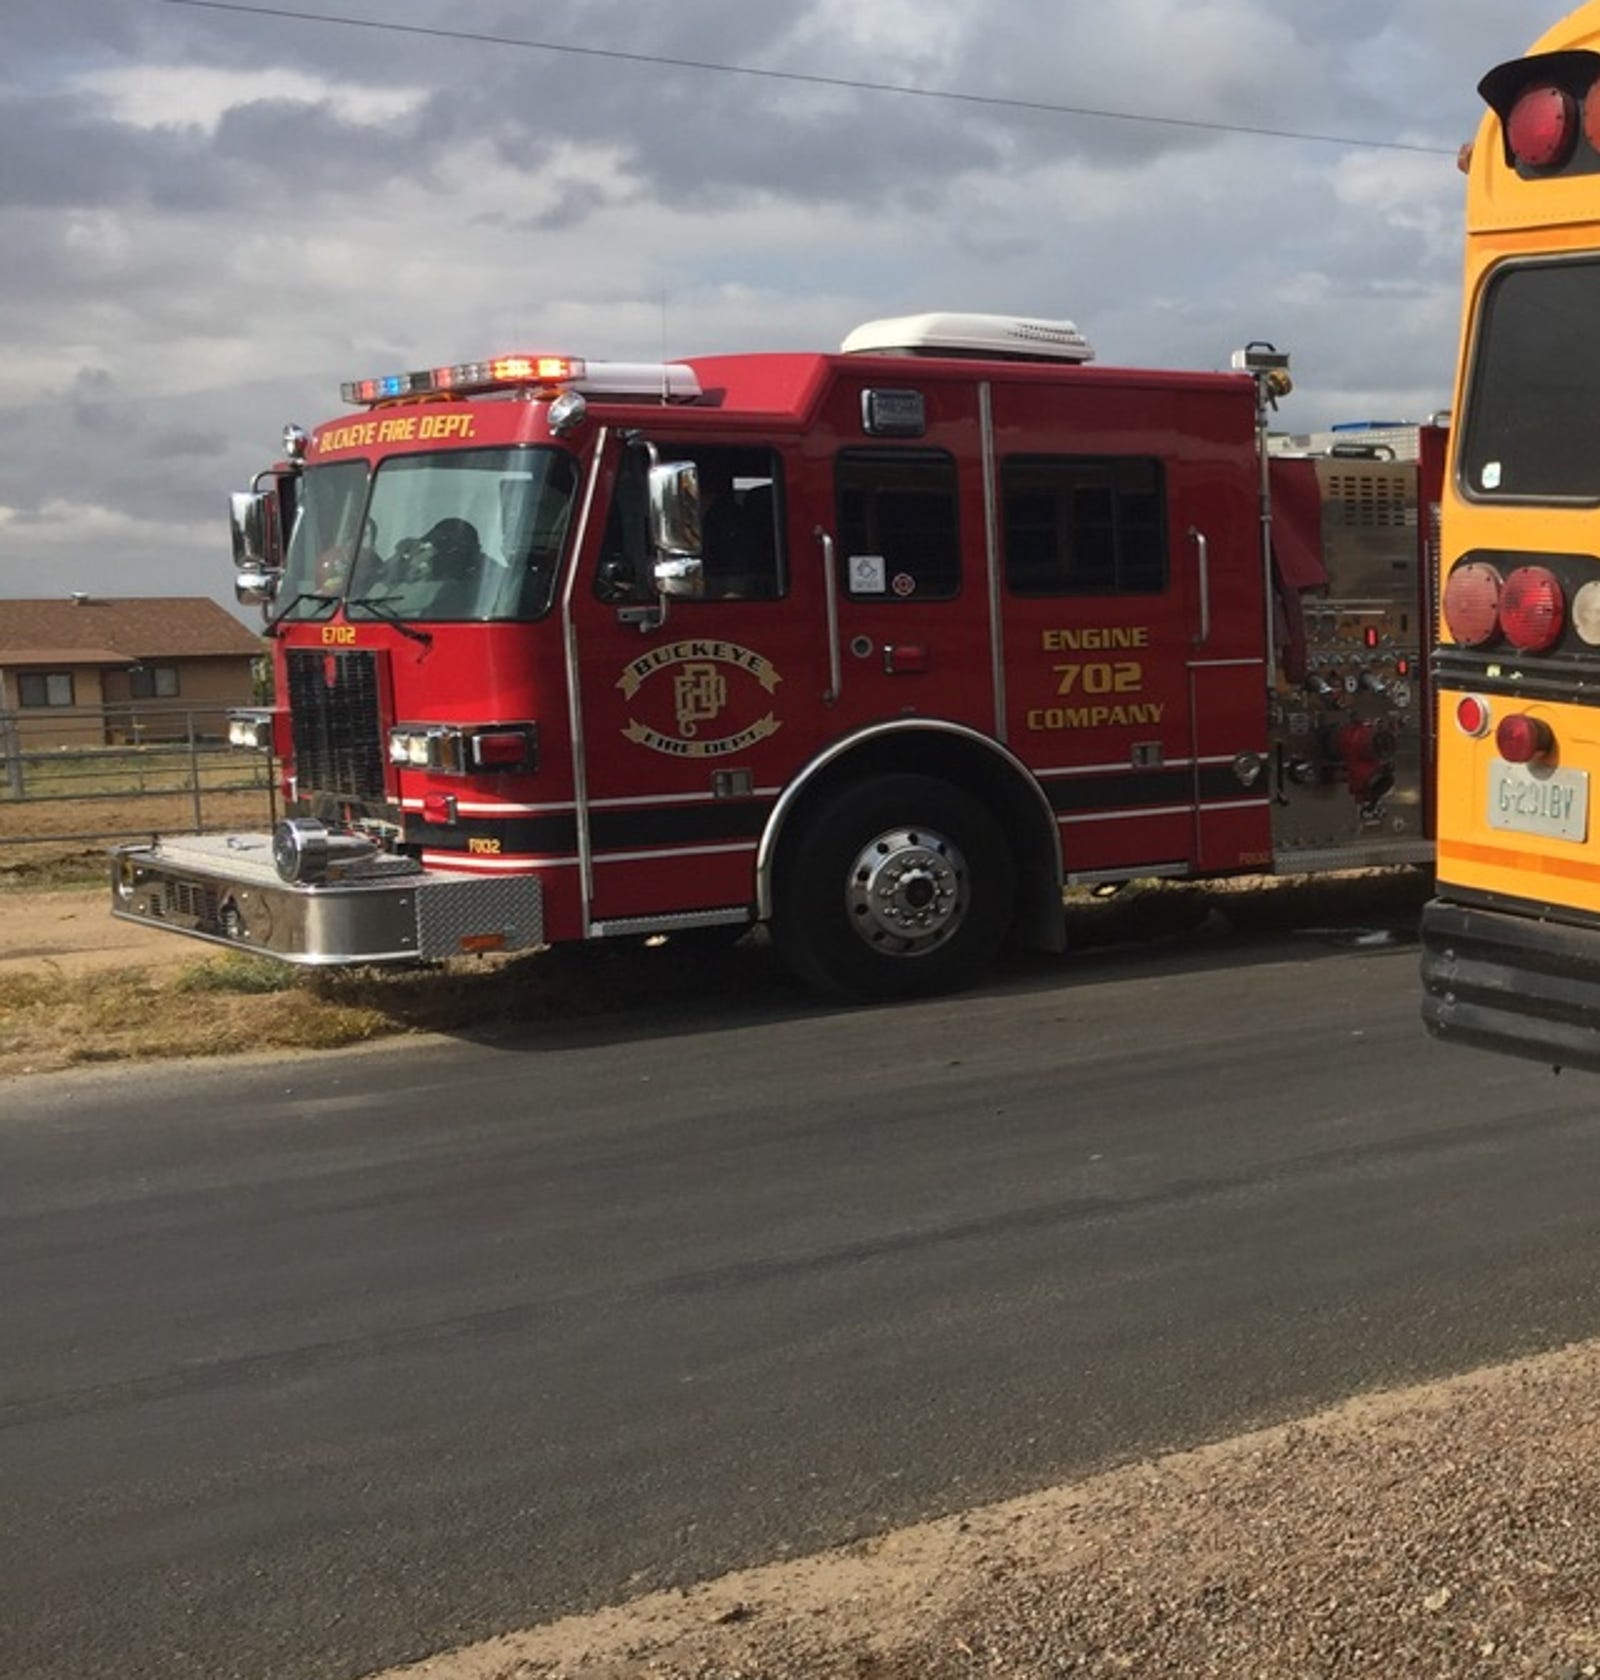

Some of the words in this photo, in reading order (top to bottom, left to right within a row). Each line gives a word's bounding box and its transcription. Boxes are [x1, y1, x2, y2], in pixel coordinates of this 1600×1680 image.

[319, 422, 377, 453] BUCKEYE
[377, 417, 418, 442] FIRE
[418, 415, 475, 439] DEPT.
[322, 626, 356, 644] E702
[1042, 627, 1149, 650] ENGINE
[633, 642, 763, 676] BUCKEYE
[1053, 661, 1142, 695] 702
[1026, 702, 1165, 730] COMPANY
[644, 732, 689, 754] FIRE
